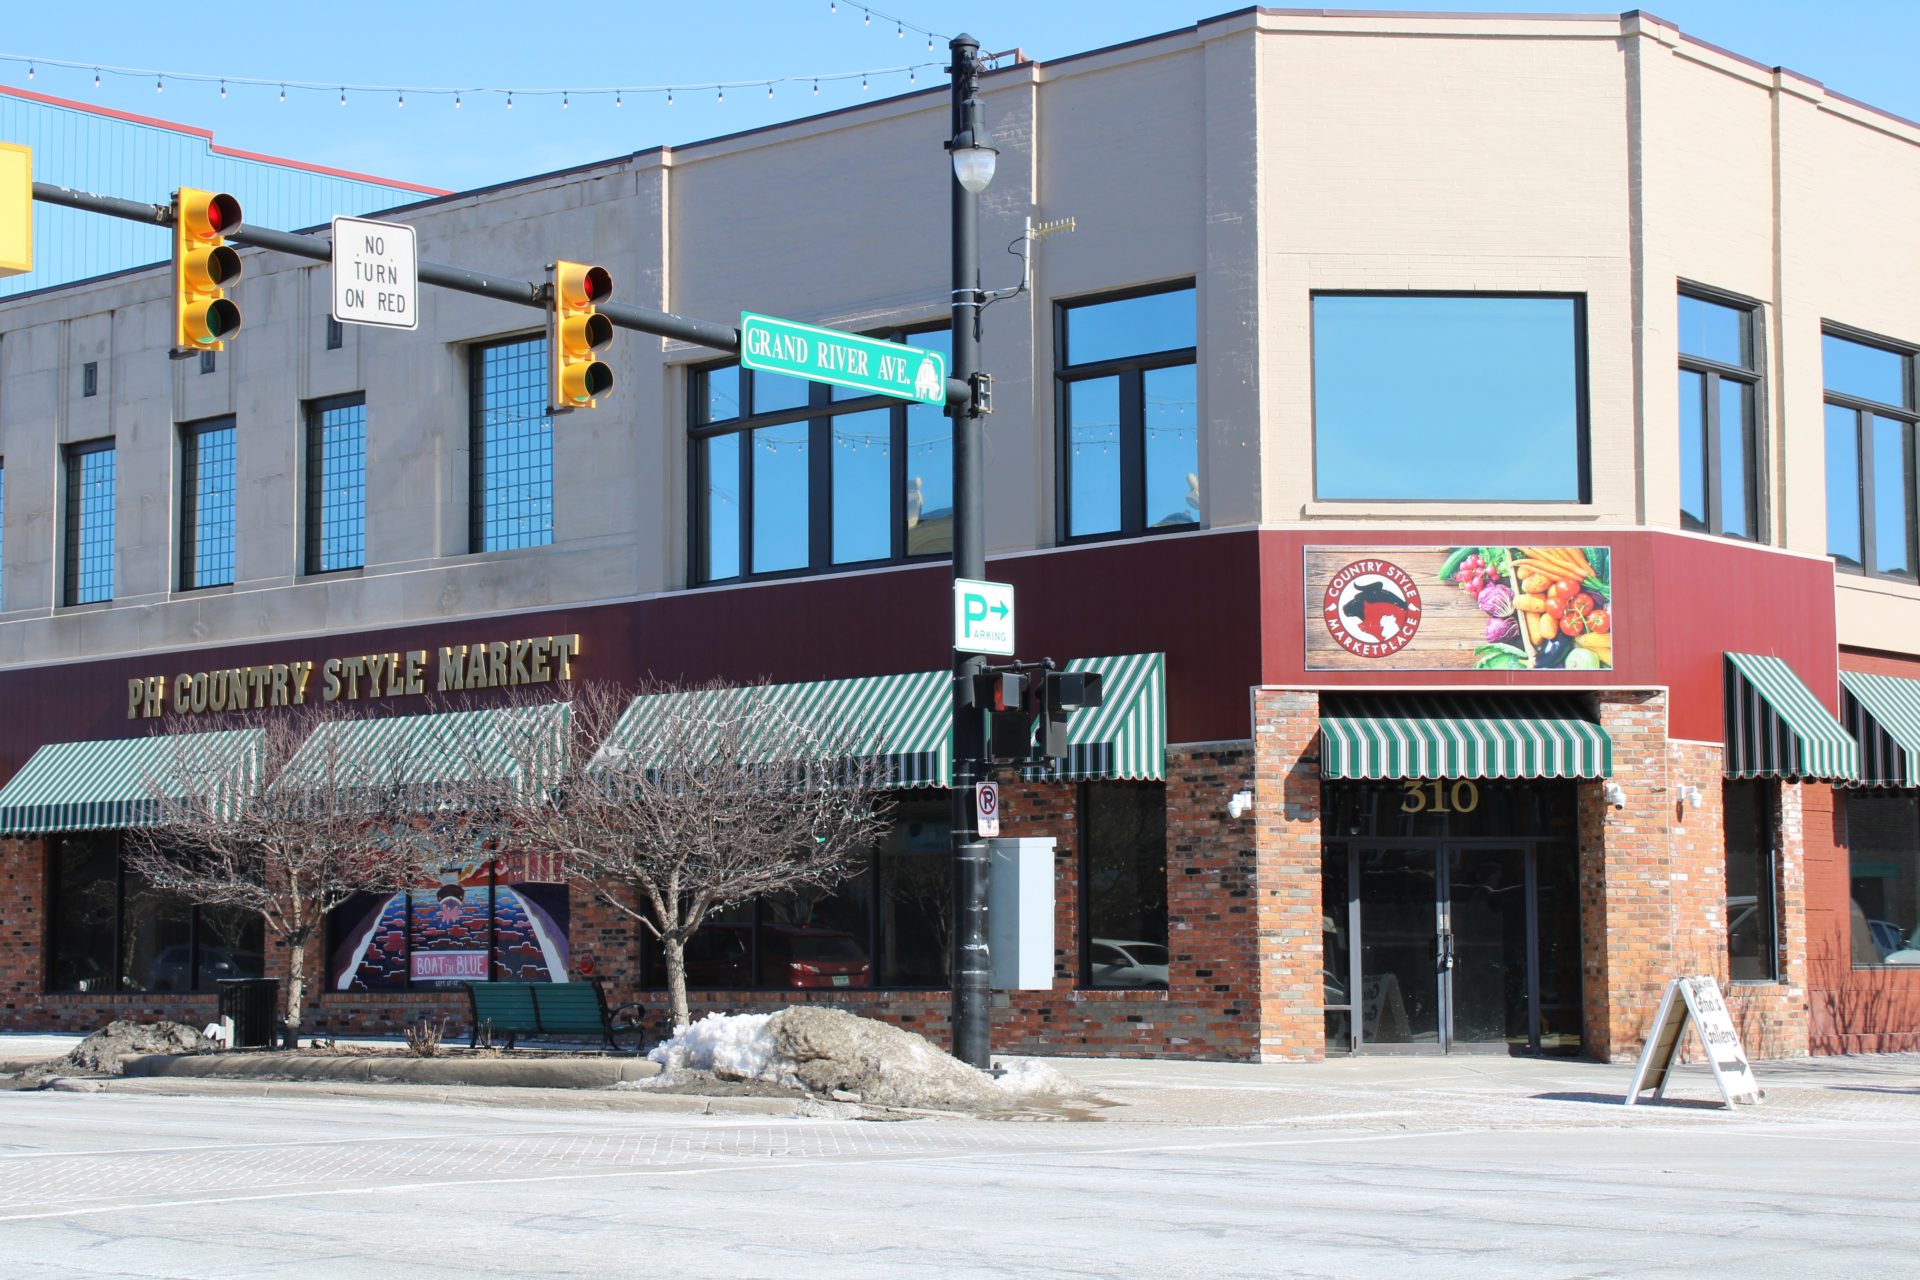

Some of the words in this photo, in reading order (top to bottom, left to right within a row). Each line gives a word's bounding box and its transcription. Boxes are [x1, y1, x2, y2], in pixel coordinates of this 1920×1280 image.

[365, 235, 384, 256] NO
[354, 261, 397, 285] TURN
[345, 288, 364, 309] ON
[378, 292, 406, 313] RED
[748, 327, 808, 364] GRAND
[817, 341, 869, 377] RIVER
[877, 354, 911, 385] AVE.
[1328, 561, 1383, 598] COUNTRY
[1386, 566, 1417, 598] STYLE
[1328, 617, 1418, 656] MARKETPLACE
[127, 675, 165, 720] PH
[174, 661, 312, 715] COUNTRY
[322, 649, 427, 702] STYLE
[437, 633, 580, 692] MARKET
[1400, 780, 1479, 813] 310
[416, 956, 446, 975] BOAT
[456, 955, 485, 975] BLUE
[1703, 1021, 1738, 1047] Gallery
